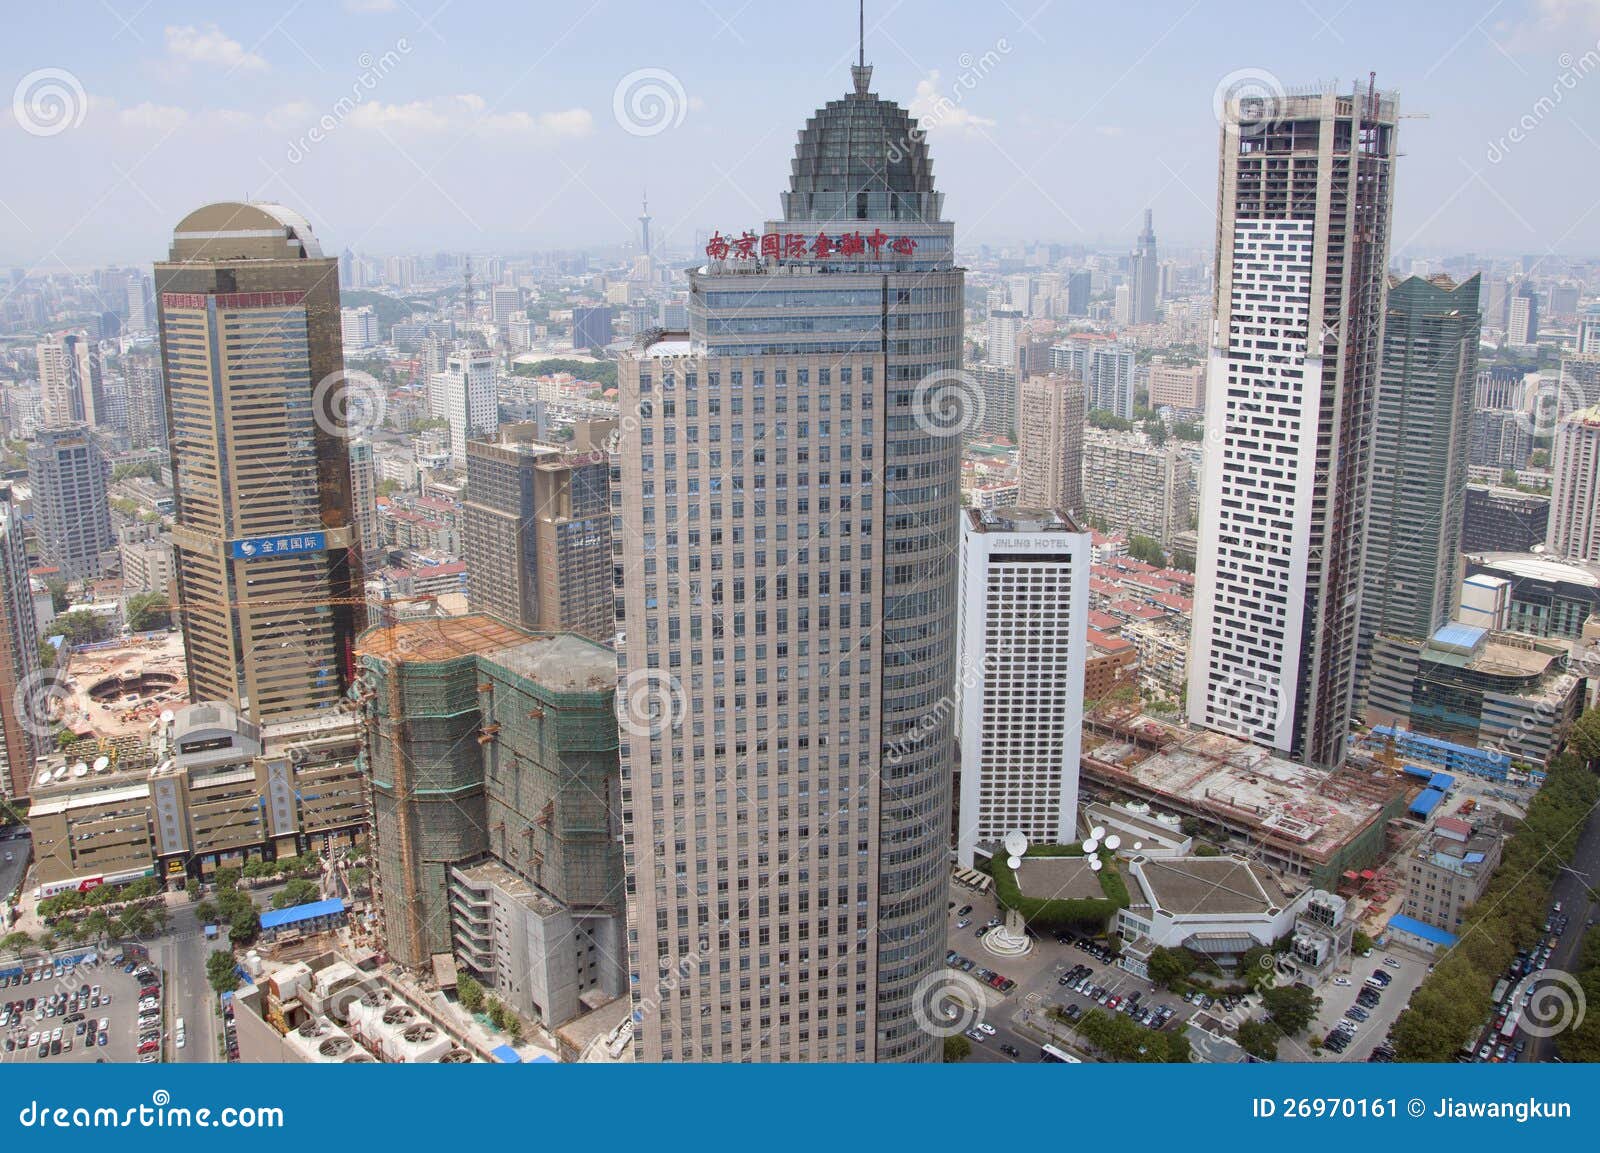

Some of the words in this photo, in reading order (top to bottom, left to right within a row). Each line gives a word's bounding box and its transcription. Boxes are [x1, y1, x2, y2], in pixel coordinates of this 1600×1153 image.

[705, 229, 918, 260] 南京国际金融中心
[993, 538, 1031, 548] JINLING
[1034, 538, 1069, 548] HOTEL
